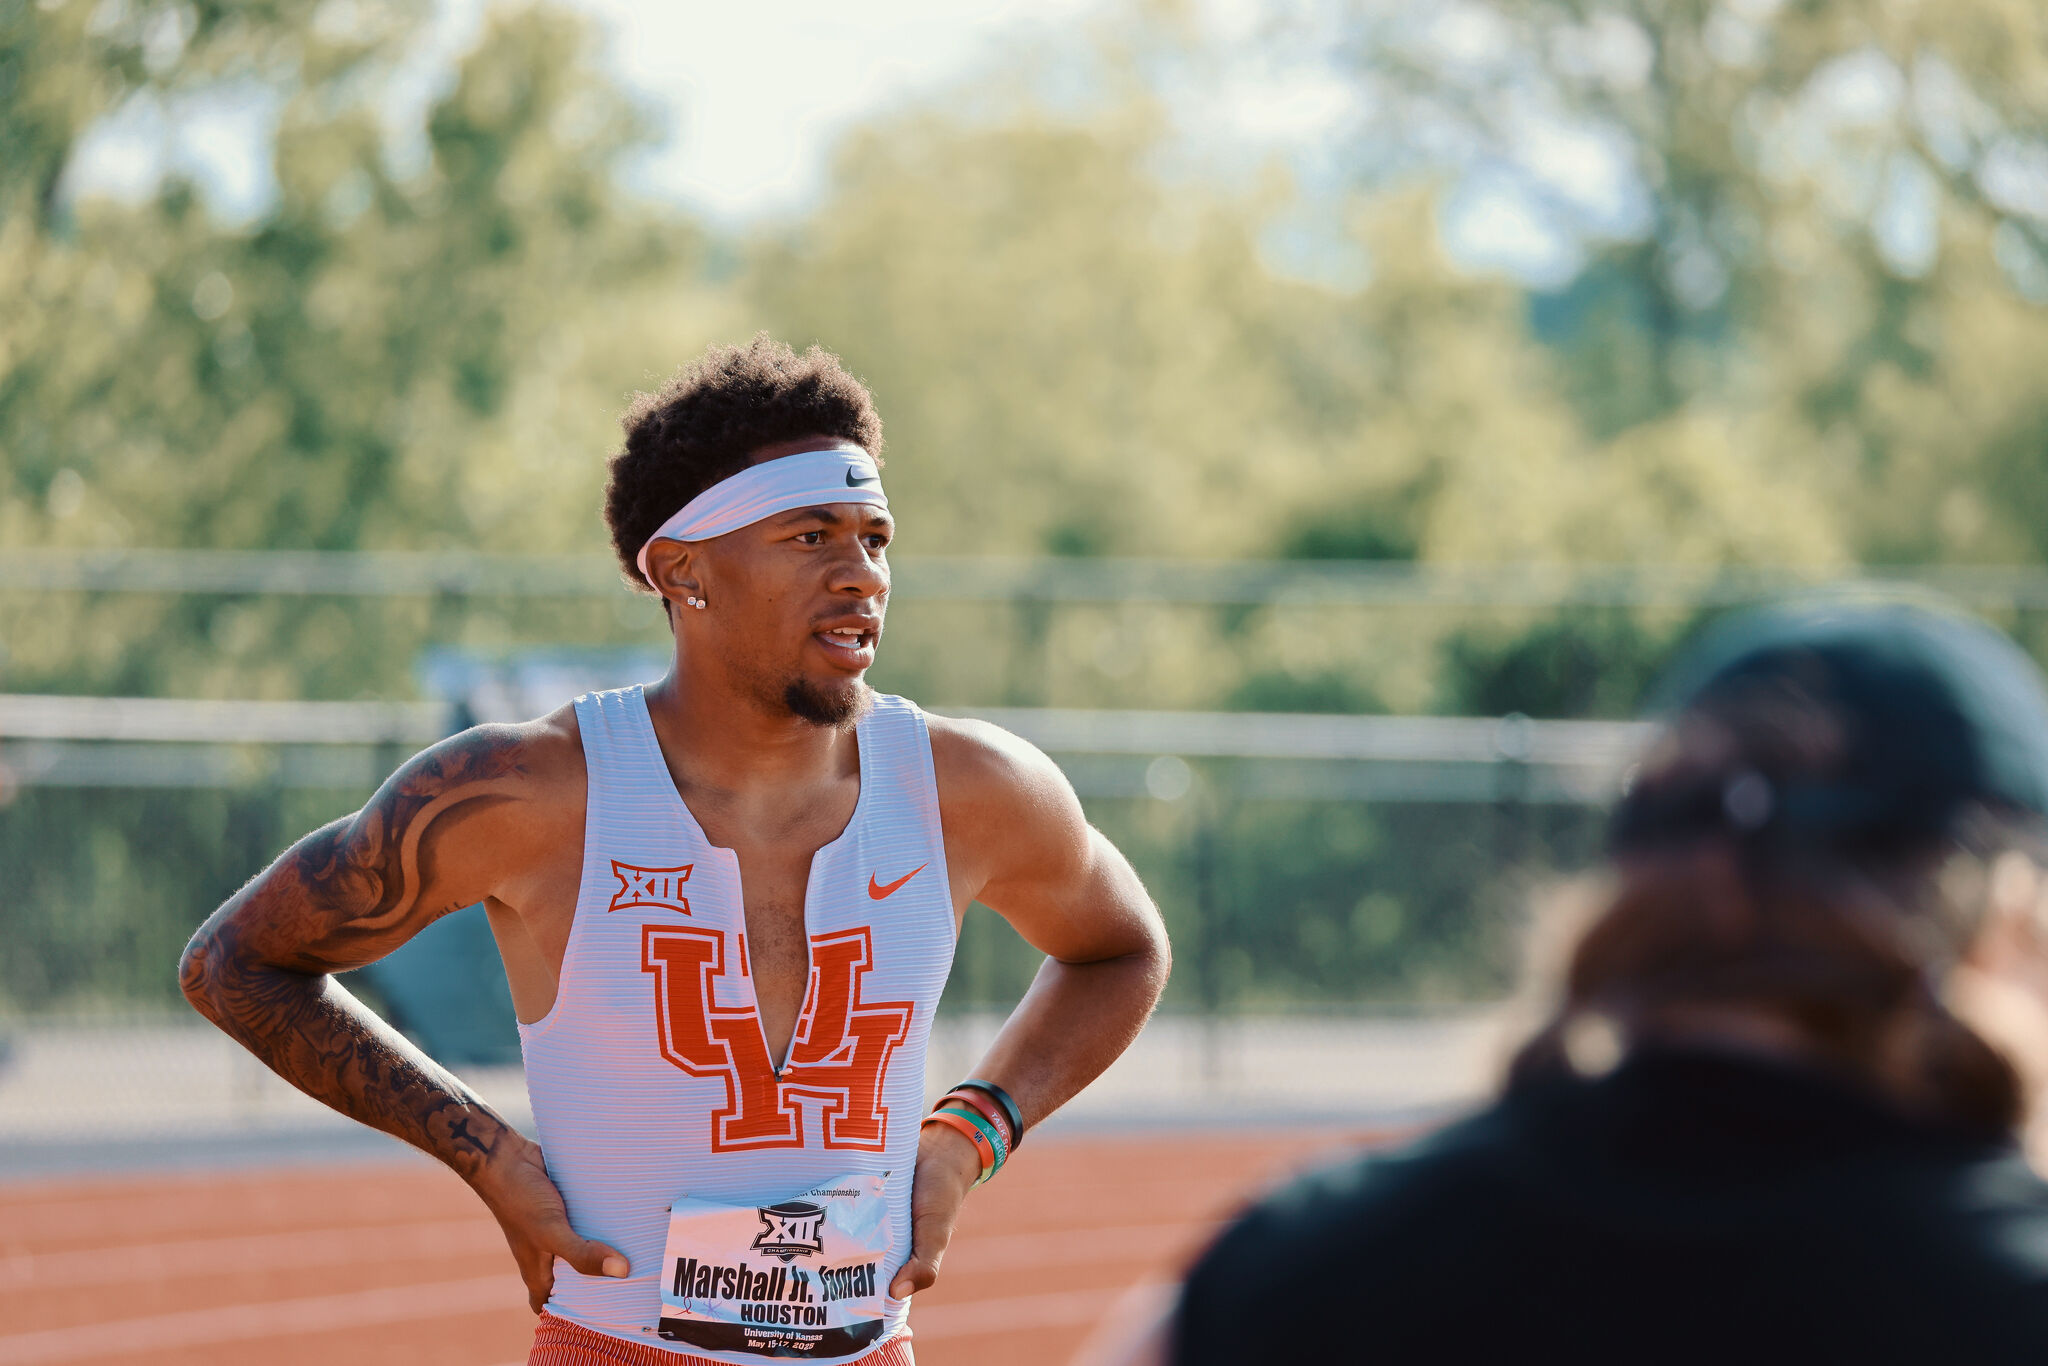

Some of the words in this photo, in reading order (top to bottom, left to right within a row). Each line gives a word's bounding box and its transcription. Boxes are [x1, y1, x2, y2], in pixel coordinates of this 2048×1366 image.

[641, 924, 915, 1153] UH
[991, 1111, 1007, 1137] TALK
[991, 1134, 1005, 1165] HOPE
[811, 1187, 861, 1199] Championships
[673, 1257, 787, 1302] Marshall
[788, 1265, 813, 1304] Jr.
[741, 1303, 828, 1326] HOUSTON
[744, 1327, 785, 1340] University
[786, 1331, 794, 1340] of
[795, 1332, 823, 1341] Kansas
[747, 1339, 766, 1349] May
[792, 1341, 815, 1351] 2025
